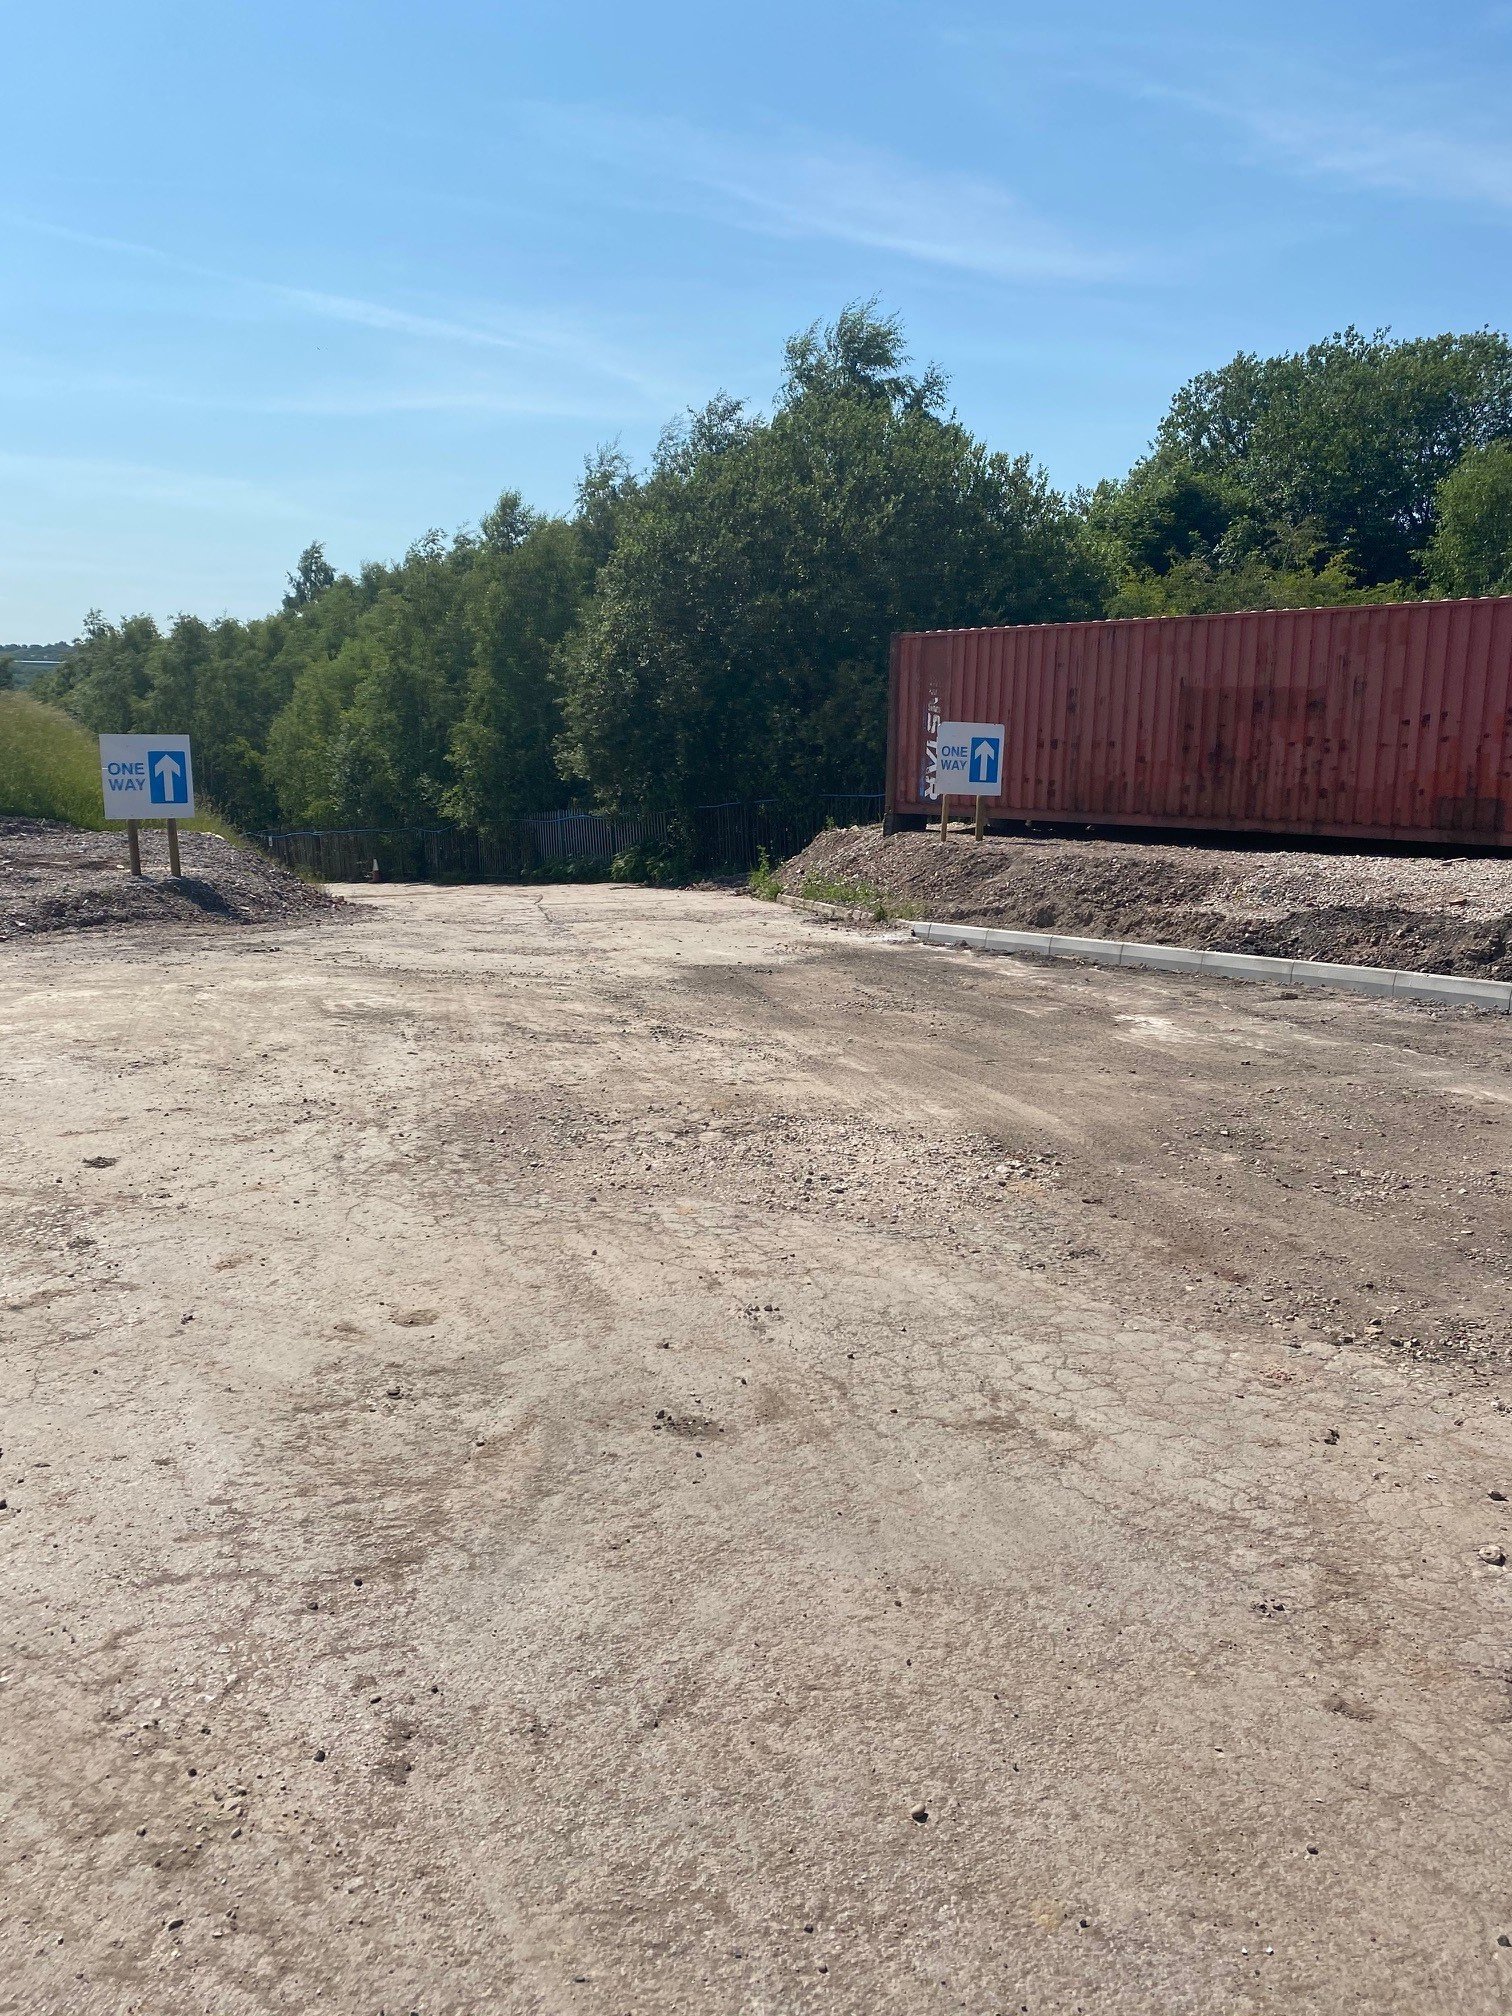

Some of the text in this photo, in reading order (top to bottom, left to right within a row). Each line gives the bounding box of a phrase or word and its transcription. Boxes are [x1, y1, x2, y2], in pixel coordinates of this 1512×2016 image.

[941, 745, 968, 758] ONE
[107, 762, 145, 776] ONE
[940, 759, 967, 771] WAY
[108, 778, 146, 791] WAY
